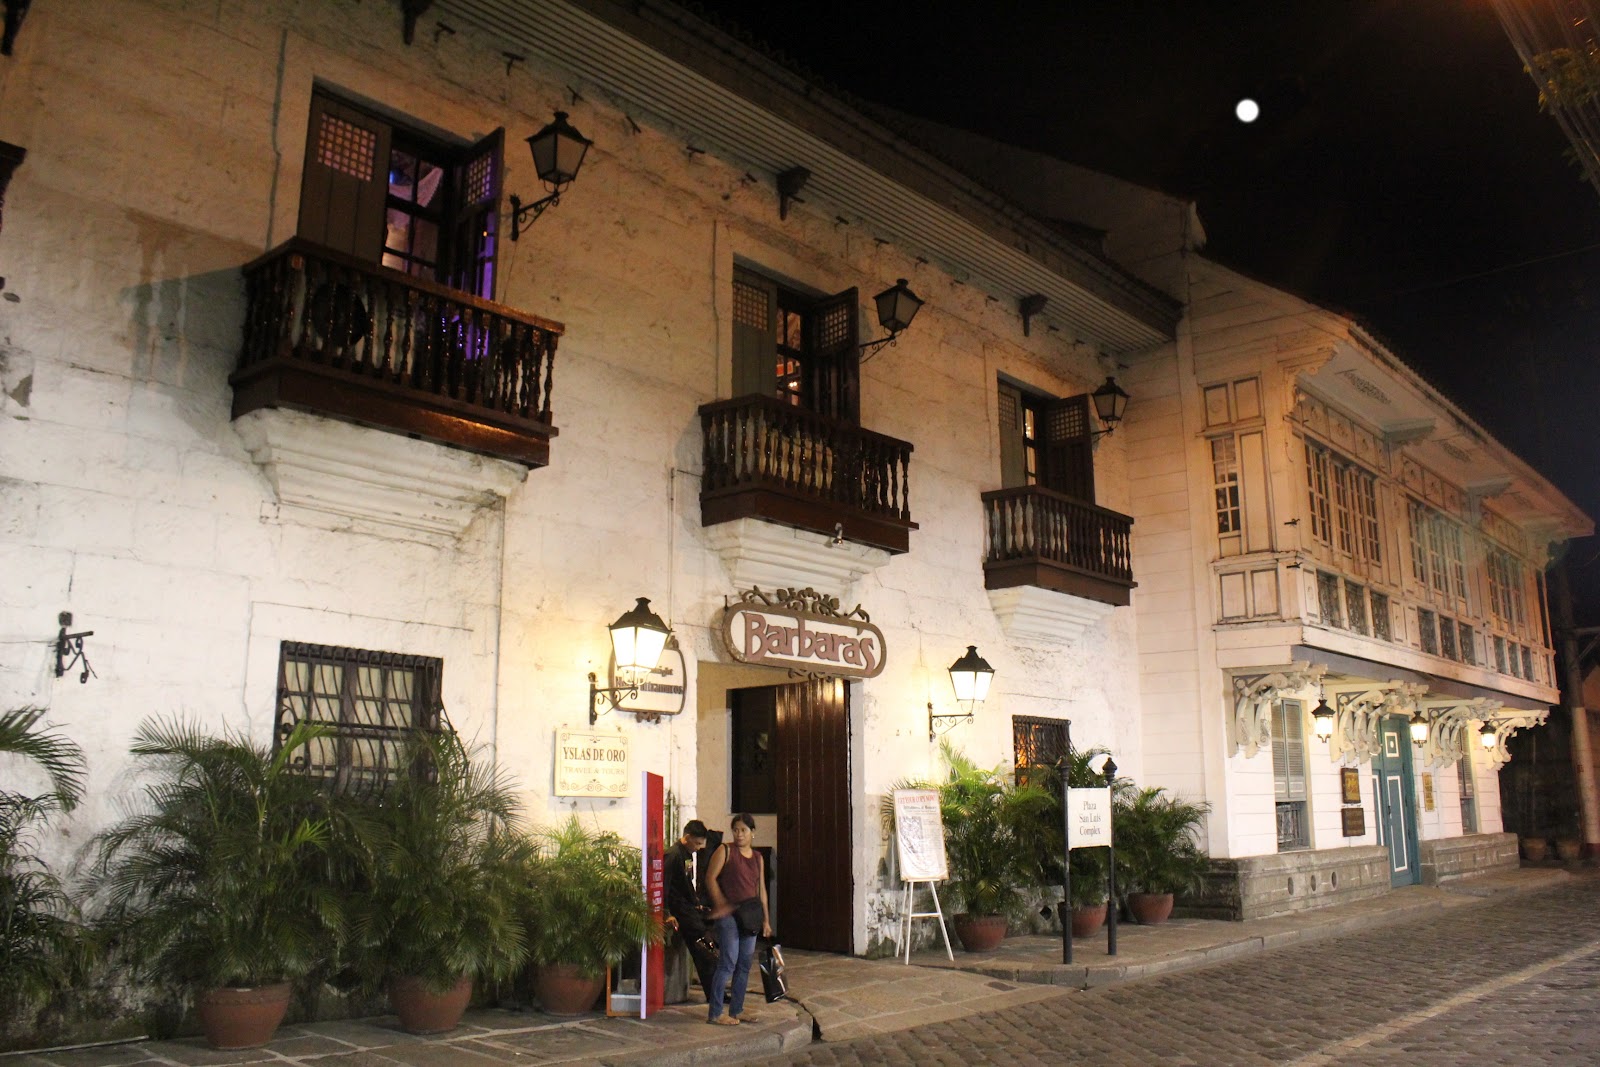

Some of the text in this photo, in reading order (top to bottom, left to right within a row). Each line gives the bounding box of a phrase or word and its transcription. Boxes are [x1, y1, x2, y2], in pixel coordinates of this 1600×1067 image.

[563, 746, 626, 762] YSLAS DE ORO
[564, 766, 592, 774] TRAVEL
[1083, 801, 1096, 810] Plaza
[1079, 813, 1102, 823] San Luis
[1079, 826, 1101, 837] Complex
